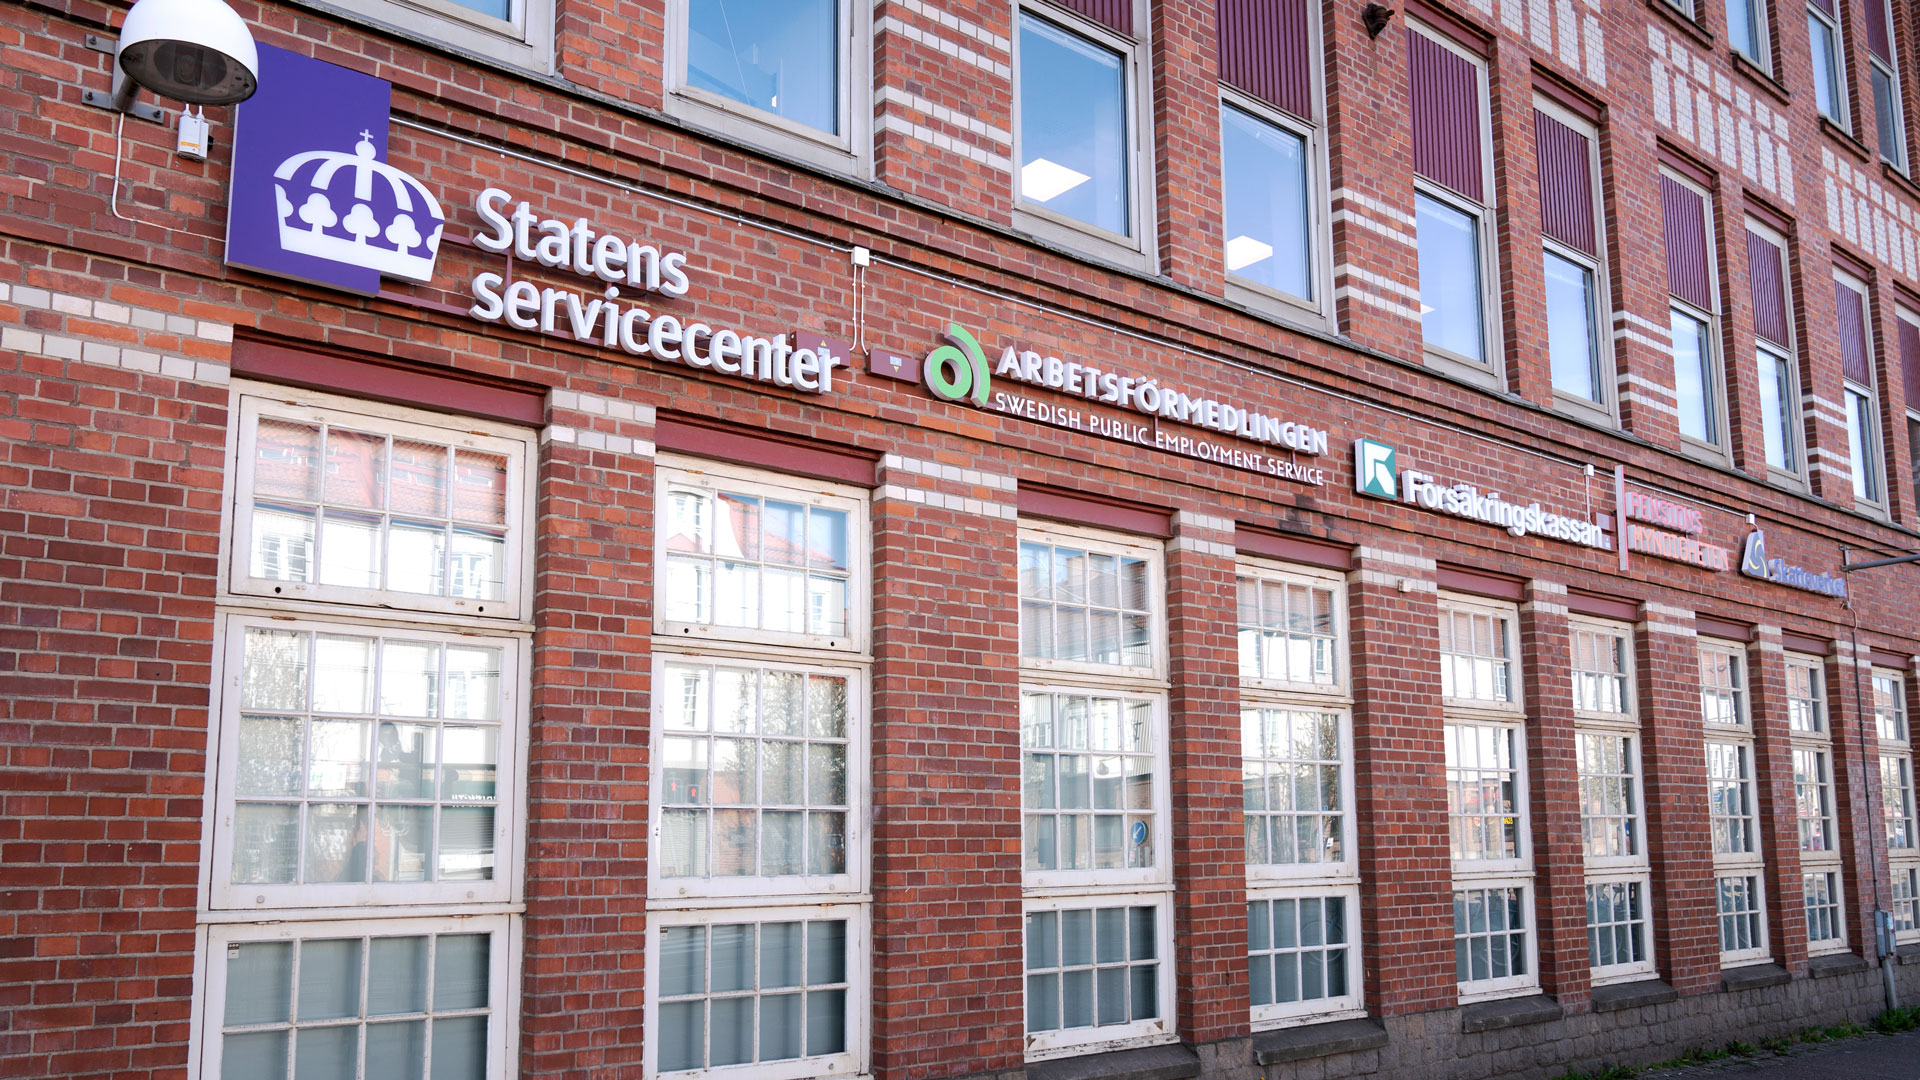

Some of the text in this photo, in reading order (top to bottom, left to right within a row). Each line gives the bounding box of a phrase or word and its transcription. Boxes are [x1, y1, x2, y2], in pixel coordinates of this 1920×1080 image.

[473, 188, 689, 297] Statens
[469, 272, 841, 394] servicecenter
[995, 392, 1324, 486] SWEDISH PUBLIC EMPLOYMENT SERVICE
[996, 345, 1328, 456] ARBETSFÖRMEDLINGEN
[1402, 469, 1604, 550] Försäkringskassan
[1625, 491, 1703, 534] PENSIONS
[1627, 525, 1729, 571] MYNDIGHETEN
[1769, 558, 1848, 598] Skatteverket
